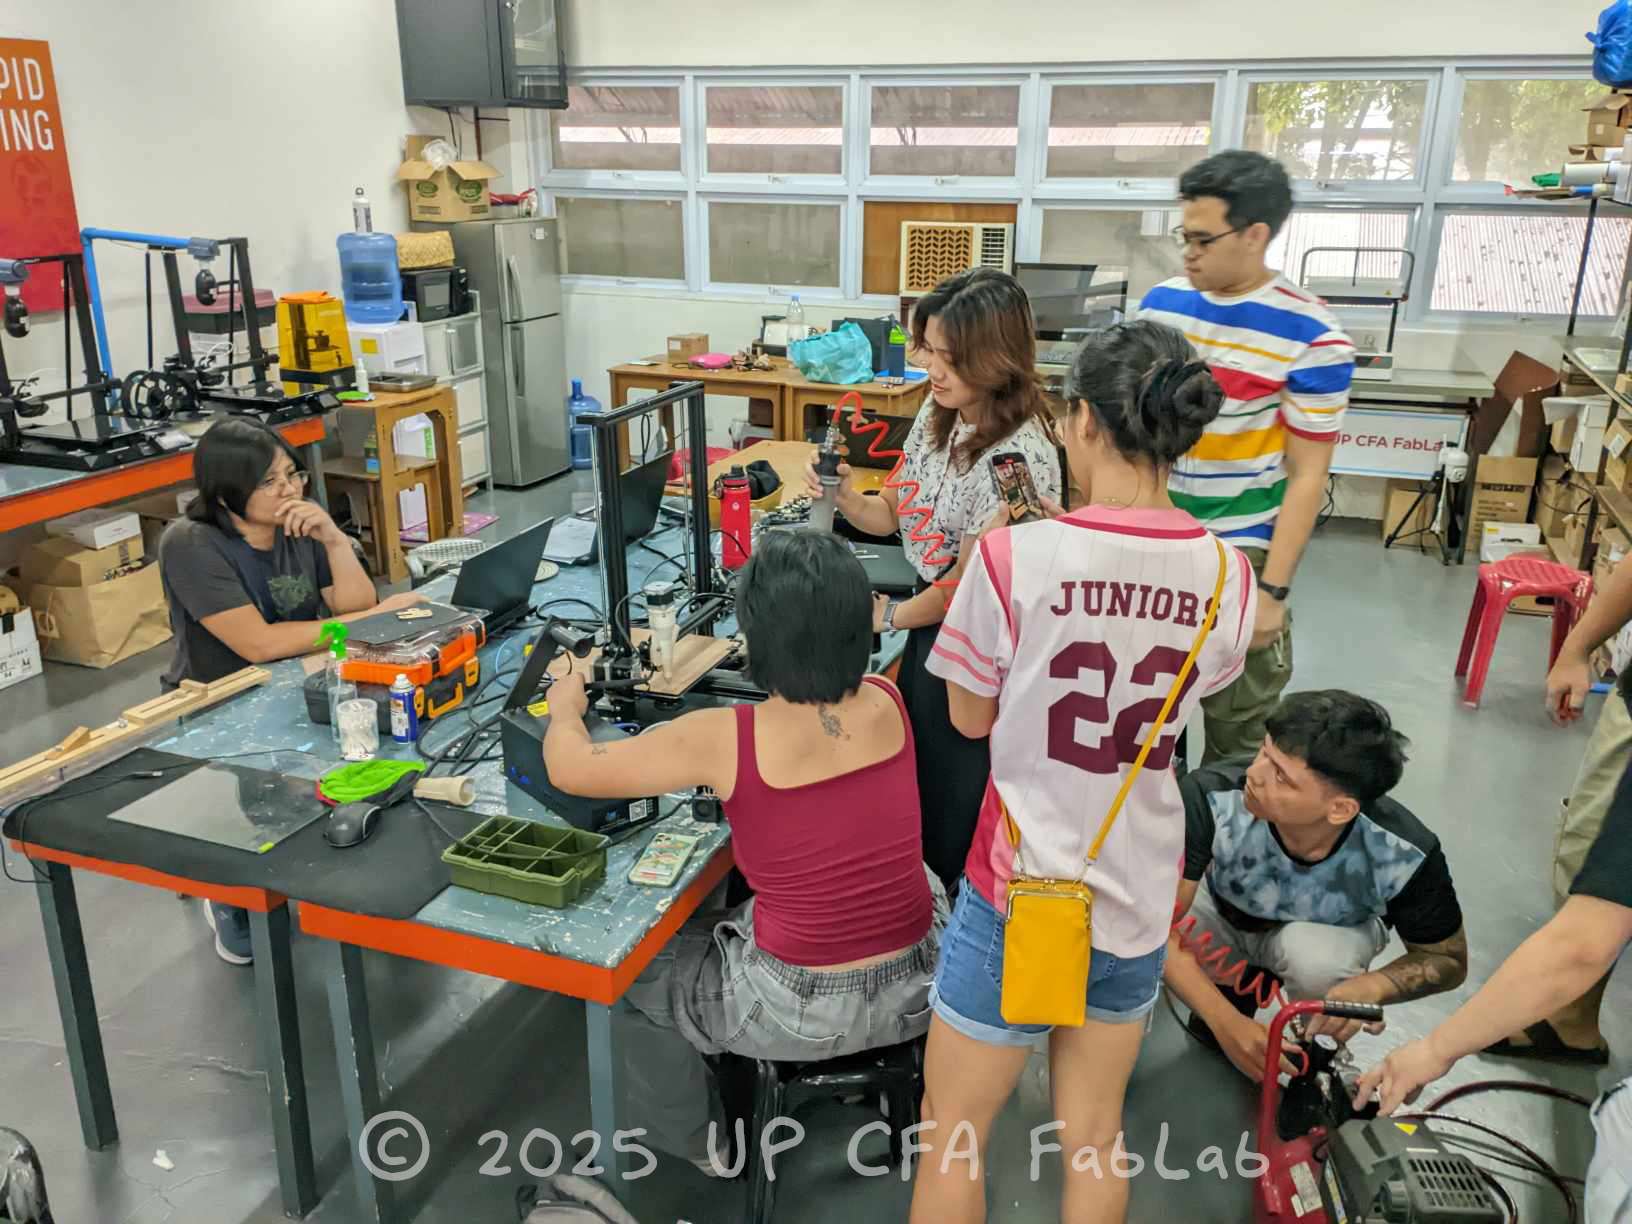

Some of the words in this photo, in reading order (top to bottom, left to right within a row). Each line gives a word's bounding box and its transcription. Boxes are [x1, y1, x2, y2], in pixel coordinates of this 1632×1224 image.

[1355, 434, 1388, 448] CFA
[1393, 437, 1443, 452] FabLa
[1050, 581, 1221, 630] JUNIORS
[1048, 641, 1200, 774] 22
